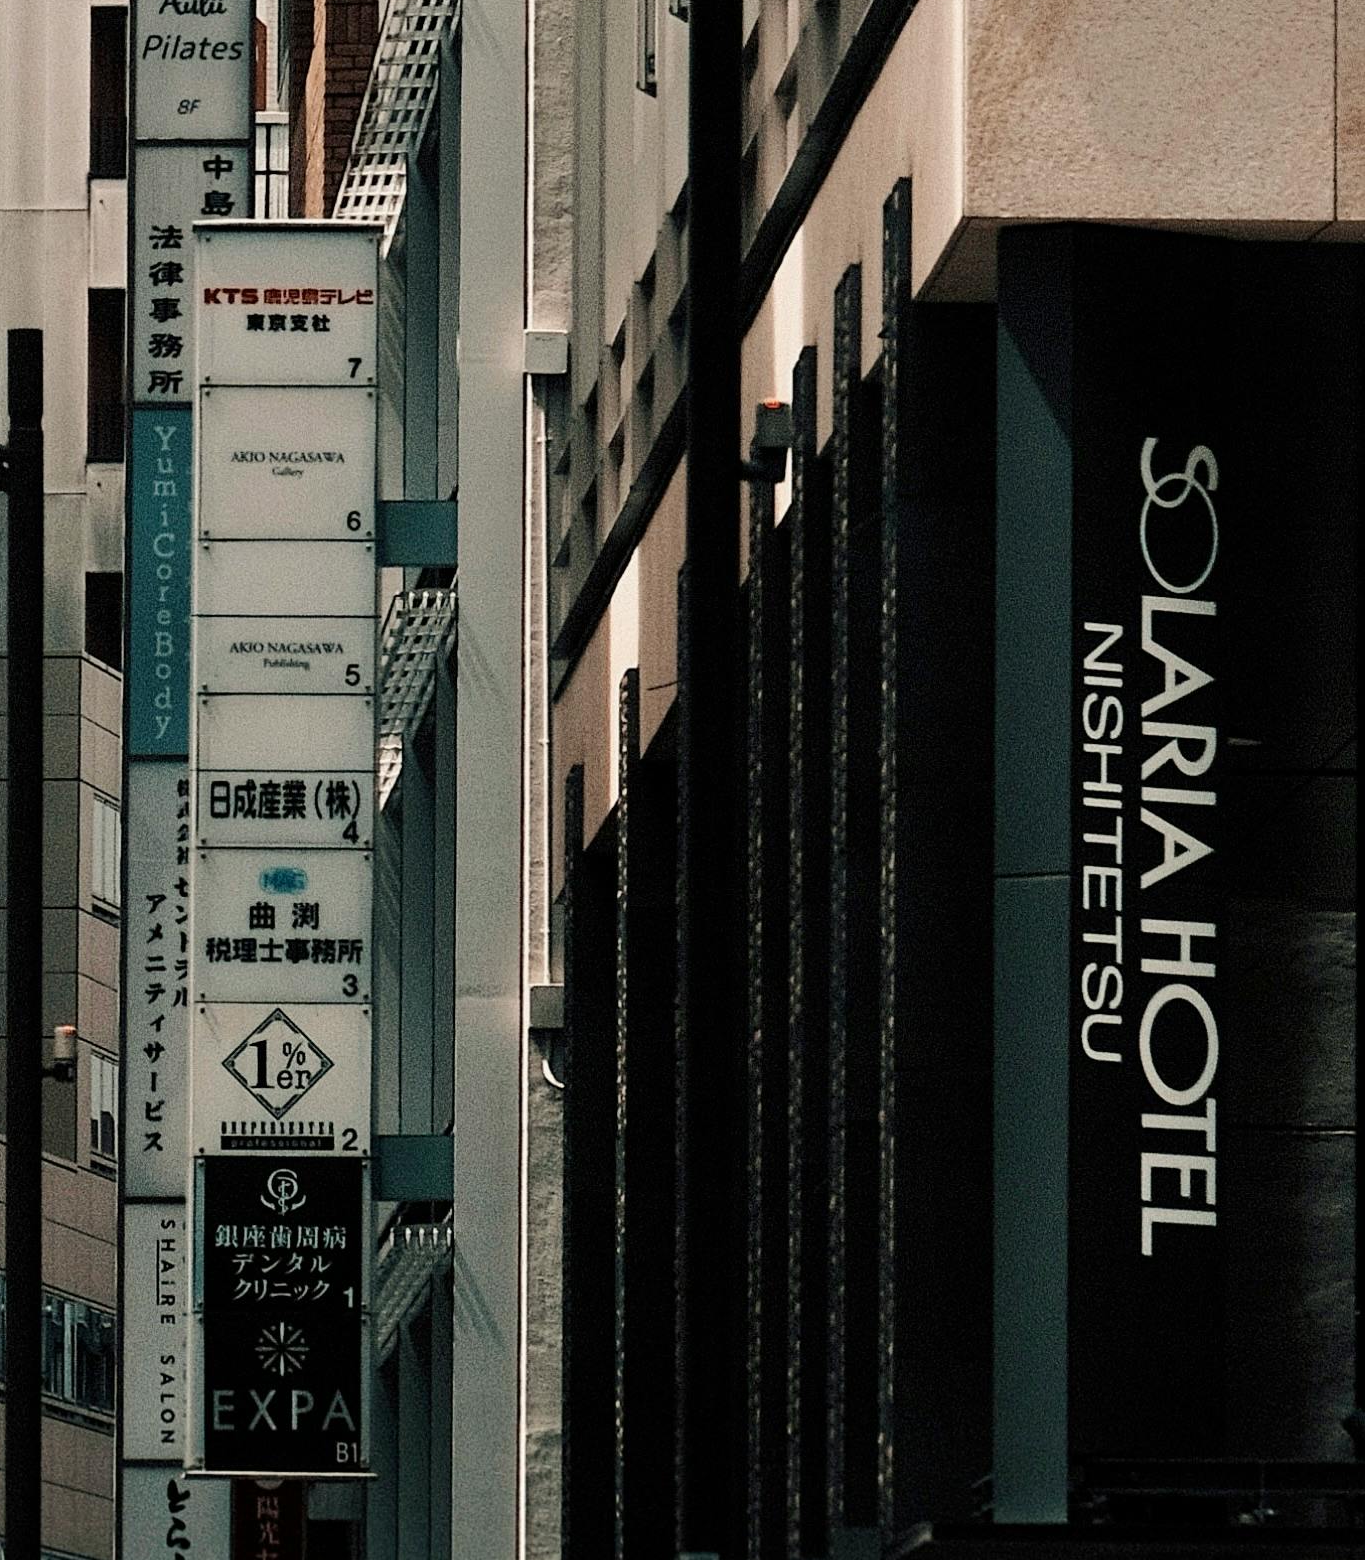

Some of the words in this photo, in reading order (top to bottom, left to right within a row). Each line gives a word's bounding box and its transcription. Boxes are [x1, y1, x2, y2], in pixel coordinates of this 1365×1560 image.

[142, 34, 244, 62] Pilates
[177, 98, 201, 116] 8F
[203, 154, 236, 216] 中島
[204, 288, 259, 305] KTS
[149, 225, 184, 394] 法律事務所
[246, 313, 331, 332] 東京支社
[347, 358, 363, 379] 7
[231, 451, 265, 463] AKIO
[269, 451, 346, 463] NAGASAWA
[345, 510, 362, 532] 6
[230, 642, 264, 653] AKIO
[268, 641, 344, 654] NAGASAWA
[1140, 434, 1218, 890] SOLARIA
[345, 664, 361, 686] 5
[342, 821, 360, 844] 4
[1082, 620, 1125, 1065] NISHITETSU
[205, 937, 364, 965] 税理士事務所
[342, 973, 359, 997] 3
[143, 893, 166, 1152] アメニティサービス
[1138, 918, 1218, 1258] HOTEL
[342, 1128, 359, 1151] 2
[214, 1224, 347, 1250] 銀座歯周病
[160, 1219, 176, 1326] SHAiRE
[231, 1252, 332, 1273] デンタル
[233, 1280, 332, 1302] クリニック
[343, 1286, 355, 1308] 1
[160, 1355, 176, 1445] SALON
[212, 1388, 357, 1431] EXPA
[336, 1442, 358, 1463] B1
